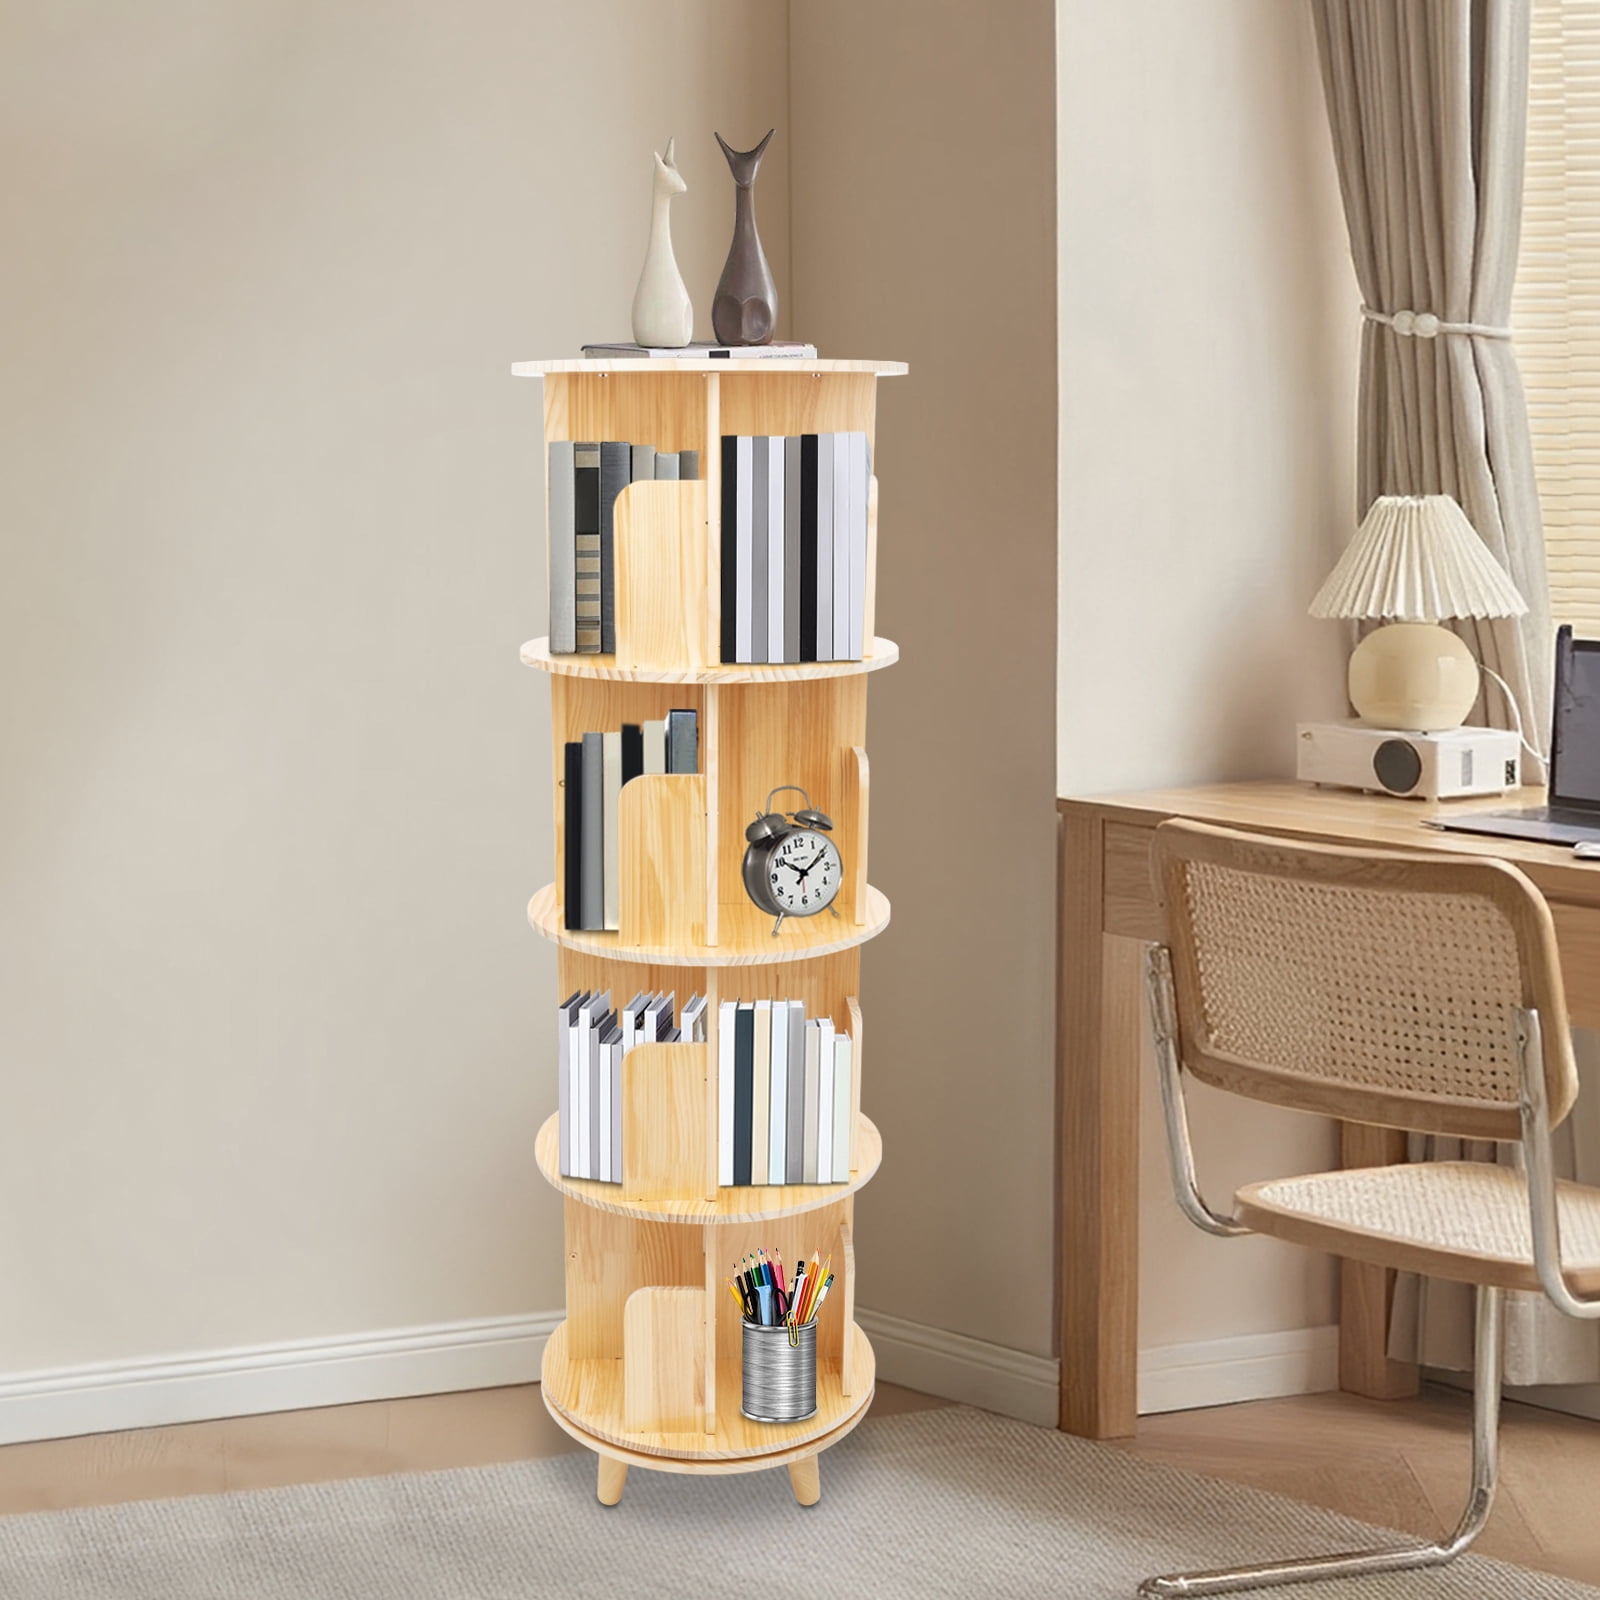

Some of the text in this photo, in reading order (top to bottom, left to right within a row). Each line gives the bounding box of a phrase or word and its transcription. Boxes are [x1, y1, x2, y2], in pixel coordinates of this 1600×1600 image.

[793, 837, 804, 849] 12
[810, 840, 815, 850] 1
[782, 844, 792, 855] 11
[775, 856, 785, 868] 10
[823, 861, 831, 872] 3
[771, 873, 778, 884] 9
[822, 876, 827, 886] 4
[777, 886, 784, 897] 8
[814, 887, 821, 898] 5
[787, 894, 794, 905] 7
[801, 895, 808, 905] 6
